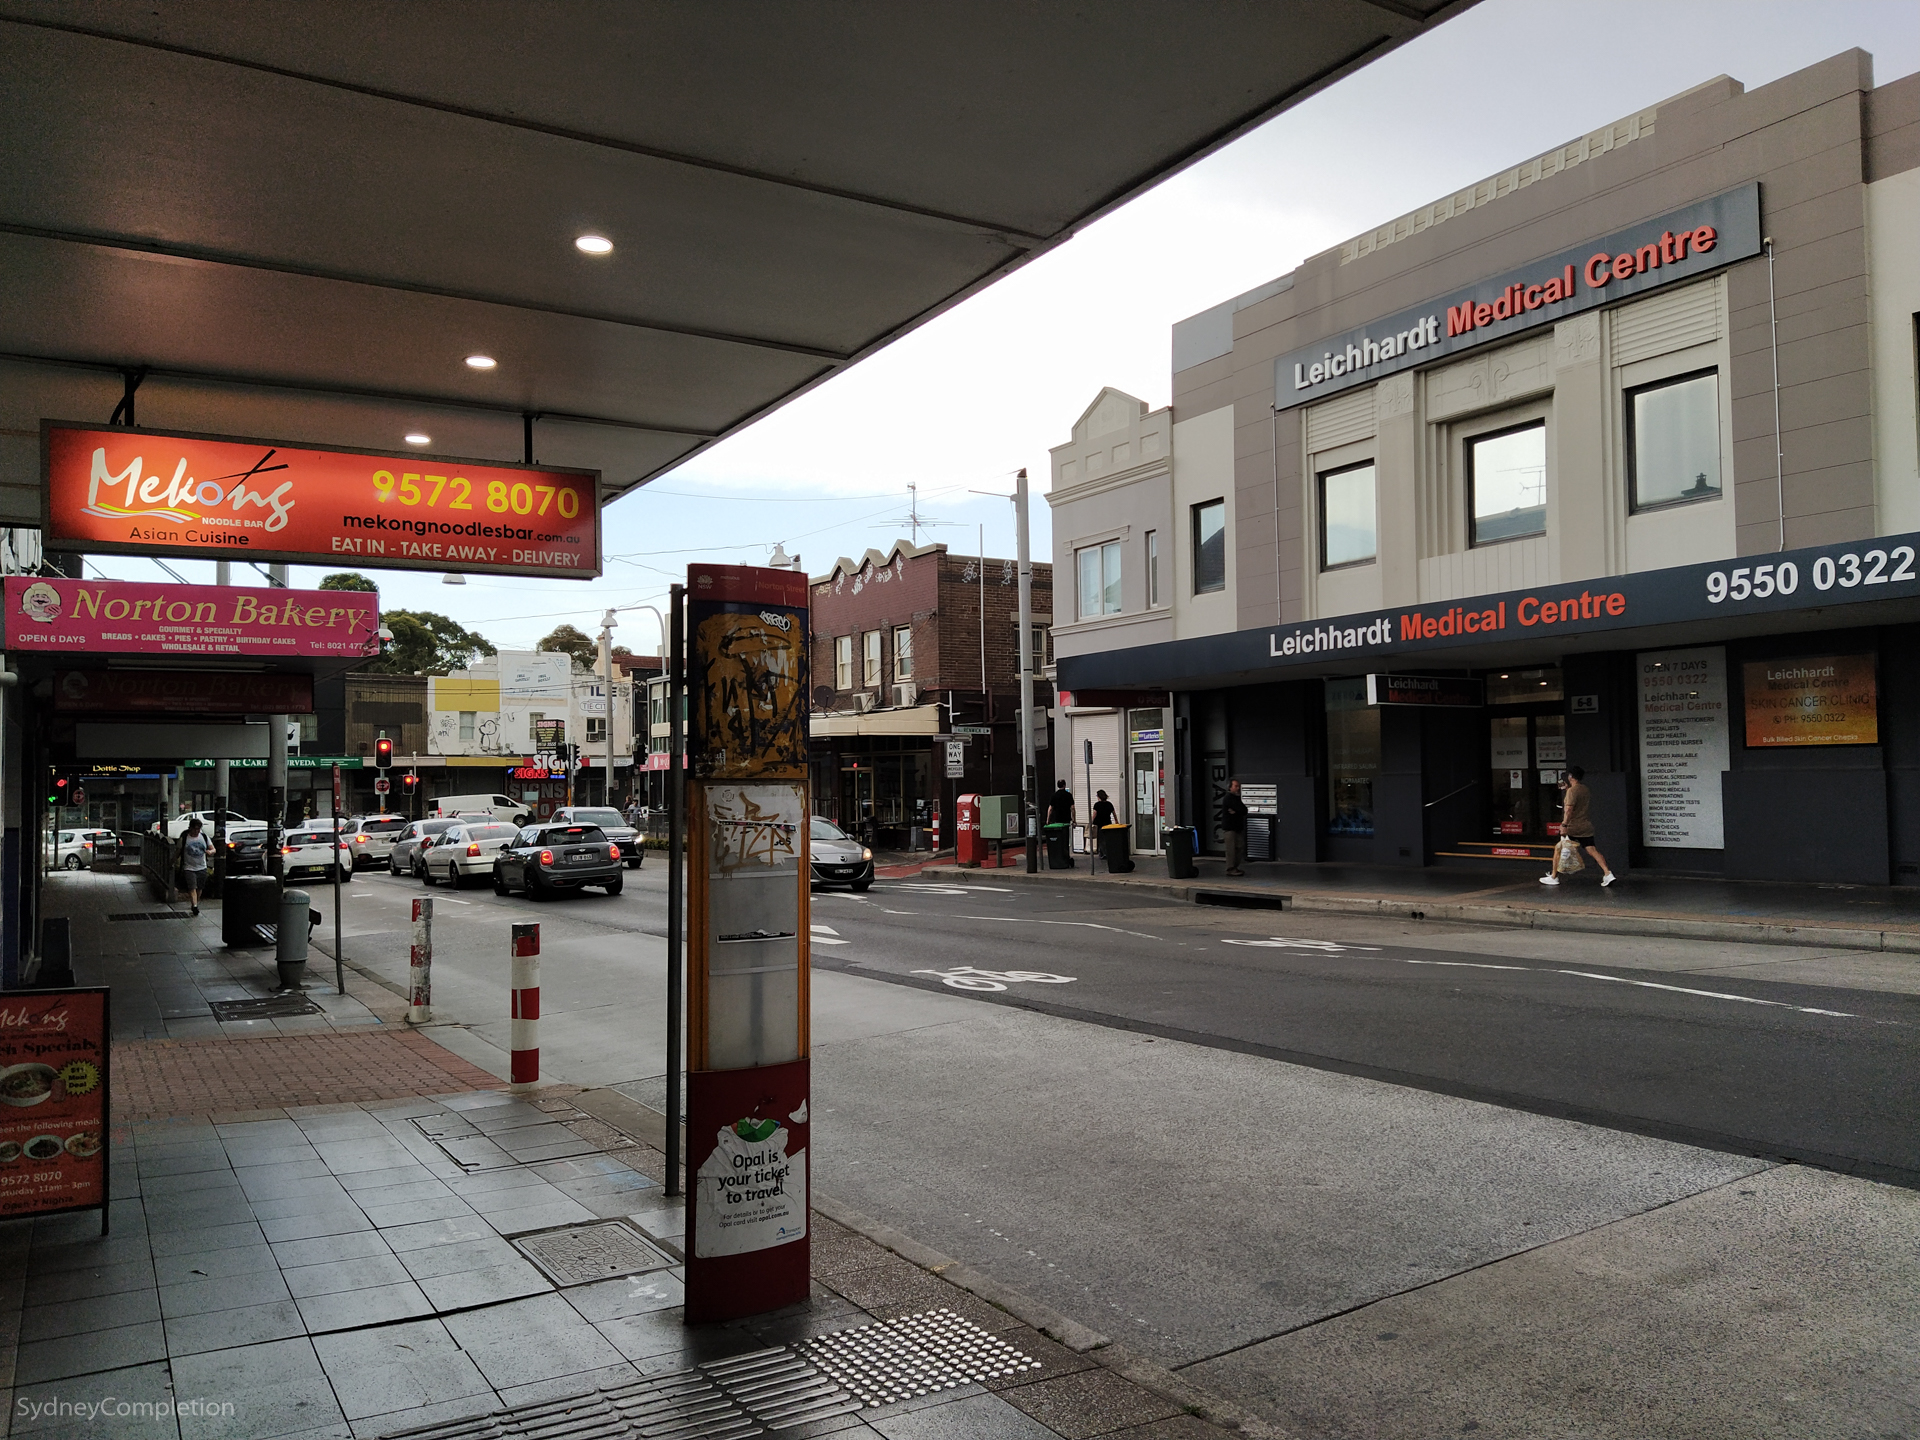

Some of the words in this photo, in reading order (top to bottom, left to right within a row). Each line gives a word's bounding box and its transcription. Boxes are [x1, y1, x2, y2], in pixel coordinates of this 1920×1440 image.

[1294, 314, 1441, 391] Leichhardt
[1446, 264, 1576, 338] Medical
[1584, 223, 1718, 290] Centre
[88, 447, 296, 533] Mekong
[372, 470, 473, 510] 9572
[486, 480, 580, 519] 8070
[202, 516, 242, 527] NOODLE
[244, 519, 264, 528] BAR
[129, 526, 179, 542] Asian
[185, 529, 250, 546] Cuisine
[343, 514, 581, 545] mekongnoodlesbar.com.au
[331, 536, 363, 553] EAT
[367, 540, 385, 554] IN
[401, 541, 442, 558] TAKE
[446, 545, 498, 561] AWAY
[512, 549, 581, 566] DELIVERY
[1706, 562, 1799, 604] 9550
[1812, 546, 1916, 591] 0322
[758, 581, 785, 591] Norton
[787, 584, 806, 594] Street
[69, 588, 217, 622] Norton
[229, 595, 367, 635] Bakery
[158, 625, 194, 634] GOURMET
[204, 627, 242, 635] SPECIALTY
[1269, 617, 1392, 658] Leichhardt
[1400, 601, 1506, 642] Medical
[1517, 590, 1626, 628] Centre
[18, 634, 48, 643] OPEN
[50, 635, 56, 643] 6
[59, 635, 86, 644] DAYS
[101, 633, 133, 641] BREADS
[141, 634, 166, 642] CAKES
[174, 634, 192, 642] PIES
[200, 635, 228, 643] PASTRY
[236, 637, 271, 645] BIRTHDAY
[310, 641, 325, 650] Tel:
[327, 642, 346, 650] 8021
[162, 643, 207, 651] WHOLESALE
[215, 644, 240, 652] RETAIL
[1644, 663, 1670, 674] OPEN
[1673, 663, 1679, 671] 7
[1681, 661, 1708, 671] DAYS
[1767, 666, 1835, 681] Leichhardt
[1388, 677, 1439, 690] Leichhardt
[1644, 676, 1673, 688] 9550
[1677, 674, 1708, 684] 0322
[1768, 679, 1809, 691] Medical
[1812, 677, 1850, 688] Centre
[1146, 696, 1168, 704] POST
[1389, 688, 1432, 703] Medical
[1434, 690, 1472, 704] Centre
[1577, 697, 1593, 707] 6-8
[1645, 691, 1700, 702] Leichhardt
[1751, 698, 1777, 709] SKIN
[1780, 696, 1827, 708] CANCER
[1830, 693, 1870, 706] CLINIC
[1645, 703, 1684, 713] Medical
[1687, 701, 1722, 711] Centre
[1801, 714, 1822, 723] 9550
[1825, 713, 1846, 722] 0322
[1833, 733, 1858, 741] Checks
[119, 765, 141, 773] Shop
[242, 758, 268, 767] CARE
[533, 754, 582, 770] SIGNS
[514, 767, 549, 779] SIGNS
[957, 823, 970, 831] POST
[23, 1039, 97, 1056] Specials
[34, 1120, 73, 1130] following
[75, 1118, 100, 1126] meals
[733, 1150, 765, 1171] Opal
[768, 1149, 779, 1164] is
[1, 1174, 30, 1186] 9572
[33, 1171, 62, 1182] 8070
[717, 1174, 752, 1191] your
[754, 1164, 790, 1183] ticket
[0, 1188, 35, 1198] aturday
[39, 1183, 63, 1193] 11am
[72, 1180, 91, 1189] 3pm
[726, 1191, 742, 1204] to
[745, 1181, 784, 1201] travel
[733, 1210, 752, 1219] details
[766, 1205, 775, 1214] get
[775, 1203, 786, 1211] your
[718, 1220, 733, 1229] Opal
[733, 1218, 746, 1226] card
[747, 1216, 758, 1224] visit
[758, 1210, 790, 1222] opal.com.au
